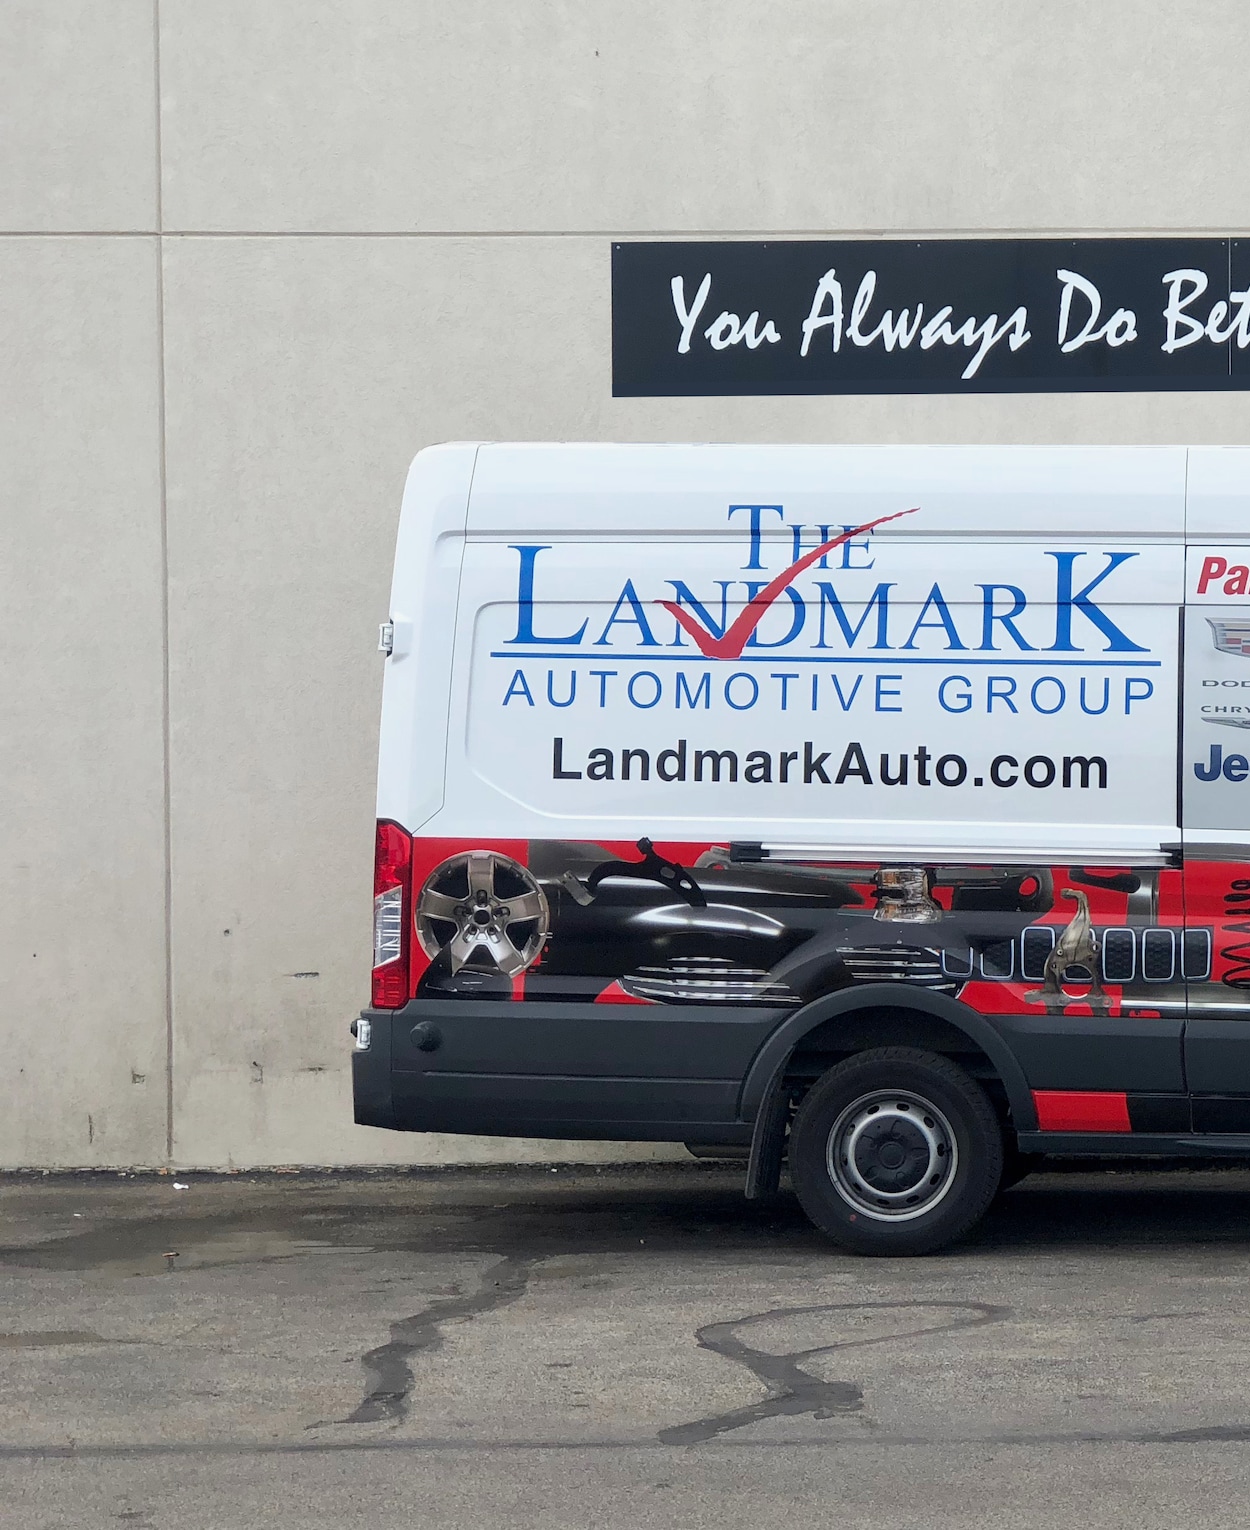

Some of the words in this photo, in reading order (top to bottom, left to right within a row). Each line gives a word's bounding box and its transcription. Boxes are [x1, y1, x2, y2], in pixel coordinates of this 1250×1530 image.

[671, 272, 781, 354] You
[800, 268, 1032, 380] Always
[1056, 268, 1138, 354] Do
[728, 504, 876, 570] THE
[502, 545, 1151, 653] LANDMARK
[502, 669, 904, 712] AUTOMOTIVE
[938, 674, 1154, 715] GROUP
[553, 737, 1108, 789] LandmarkAuto.com
